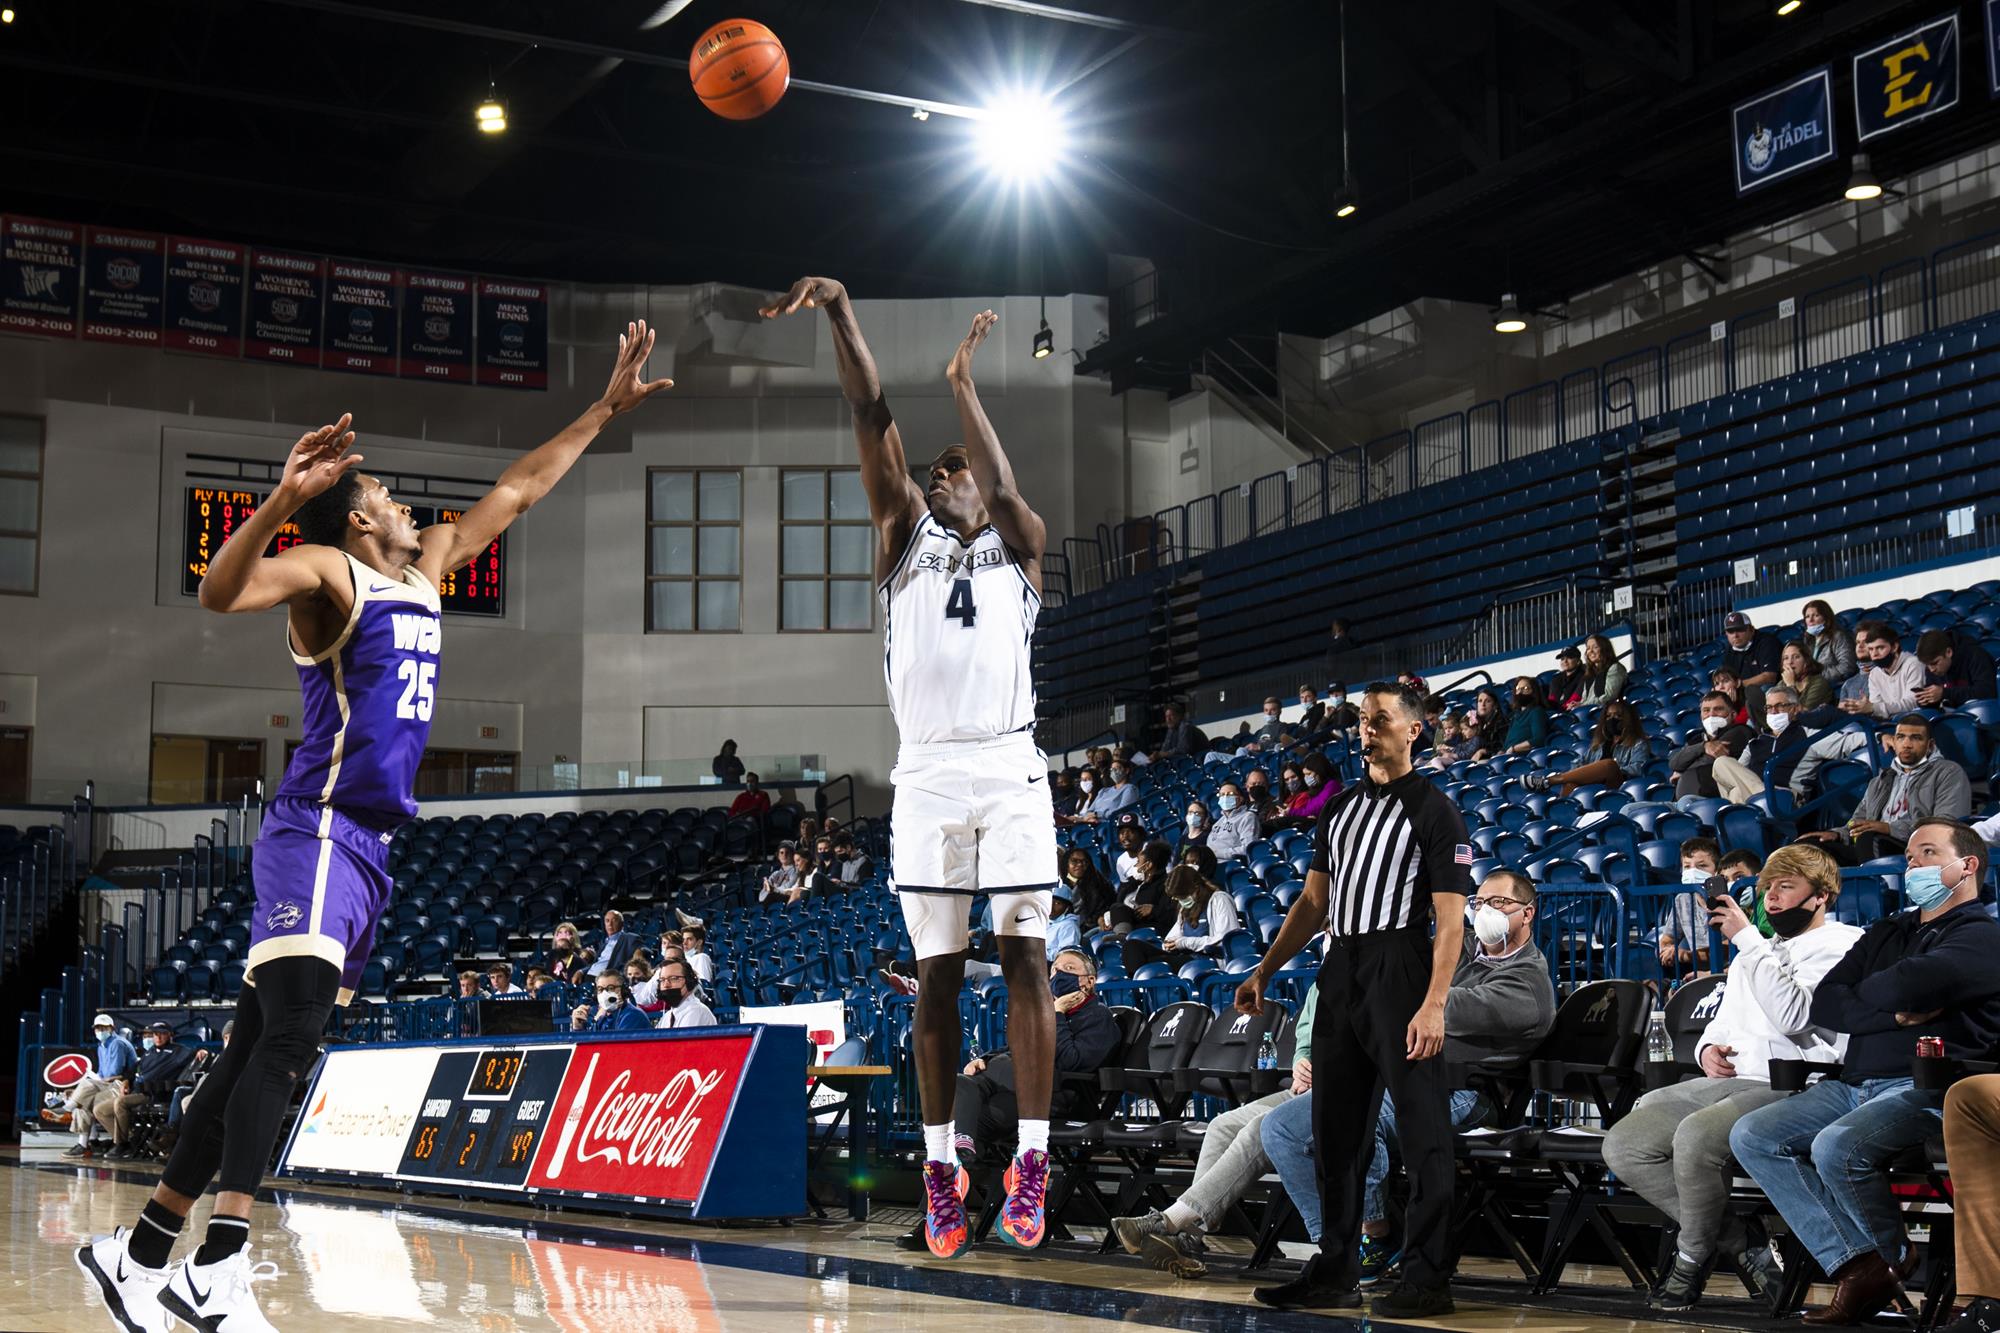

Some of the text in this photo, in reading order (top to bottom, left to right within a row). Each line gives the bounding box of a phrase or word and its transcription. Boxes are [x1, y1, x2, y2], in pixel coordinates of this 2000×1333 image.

[1883, 41, 1933, 118] E
[11, 222, 73, 240] SAMFORD
[14, 239, 69, 255] WOMEN'S
[95, 234, 157, 250] SAMFORD
[6, 248, 76, 267] BASKETBALL
[176, 243, 236, 260] SAMFORD
[186, 260, 226, 274] WOMEN'S
[257, 255, 316, 271] SAMFORD
[261, 273, 311, 289] WOMEN'S
[335, 266, 391, 282] SAMFORD
[255, 281, 317, 298] BASKETBALL
[410, 276, 466, 291] SAMFORD
[485, 283, 540, 299] SAMFORD
[332, 292, 393, 308] BASKETBALL
[338, 285, 386, 299] WOMEN'S
[423, 295, 453, 306] MEN'S
[497, 303, 528, 313] MEN'S
[421, 303, 455, 315] TENNIS
[496, 310, 529, 322] TENNIS
[0, 314, 73, 331] 2009-2010
[256, 320, 312, 336] Tournament
[87, 325, 158, 341] 2009-2010
[188, 335, 217, 347] 2010
[256, 329, 310, 344] Champions
[348, 332, 374, 343] NCAA
[269, 346, 294, 358] 2011
[333, 338, 389, 353] Tournament
[412, 343, 463, 356] Champions
[487, 354, 540, 368] Tournament
[499, 349, 525, 359] NCAA
[346, 357, 372, 368] 2011
[424, 365, 449, 376] 2011
[499, 372, 524, 382] 2011
[195, 489, 252, 505] PLY FL PTS
[201, 503, 210, 517] 0
[223, 504, 232, 518] 0
[443, 511, 461, 522] PLY
[205, 519, 210, 530] 1
[200, 532, 209, 547] 2
[199, 548, 208, 560] 4
[490, 542, 498, 555] 2
[190, 562, 208, 577] 42
[470, 569, 477, 583] 3
[486, 571, 498, 585] 13
[440, 582, 498, 598] 33 0 11
[945, 577, 977, 630] 4
[396, 659, 437, 722] 25
[485, 1057, 520, 1090] 9:37
[422, 1099, 452, 1118] SAMFORD
[469, 1108, 491, 1123] PERIOD
[516, 1100, 545, 1121] GUEST
[577, 1068, 727, 1168] Coca-Cola
[415, 1127, 438, 1159] 65
[458, 1132, 476, 1166] 2
[511, 1131, 533, 1162] 49
